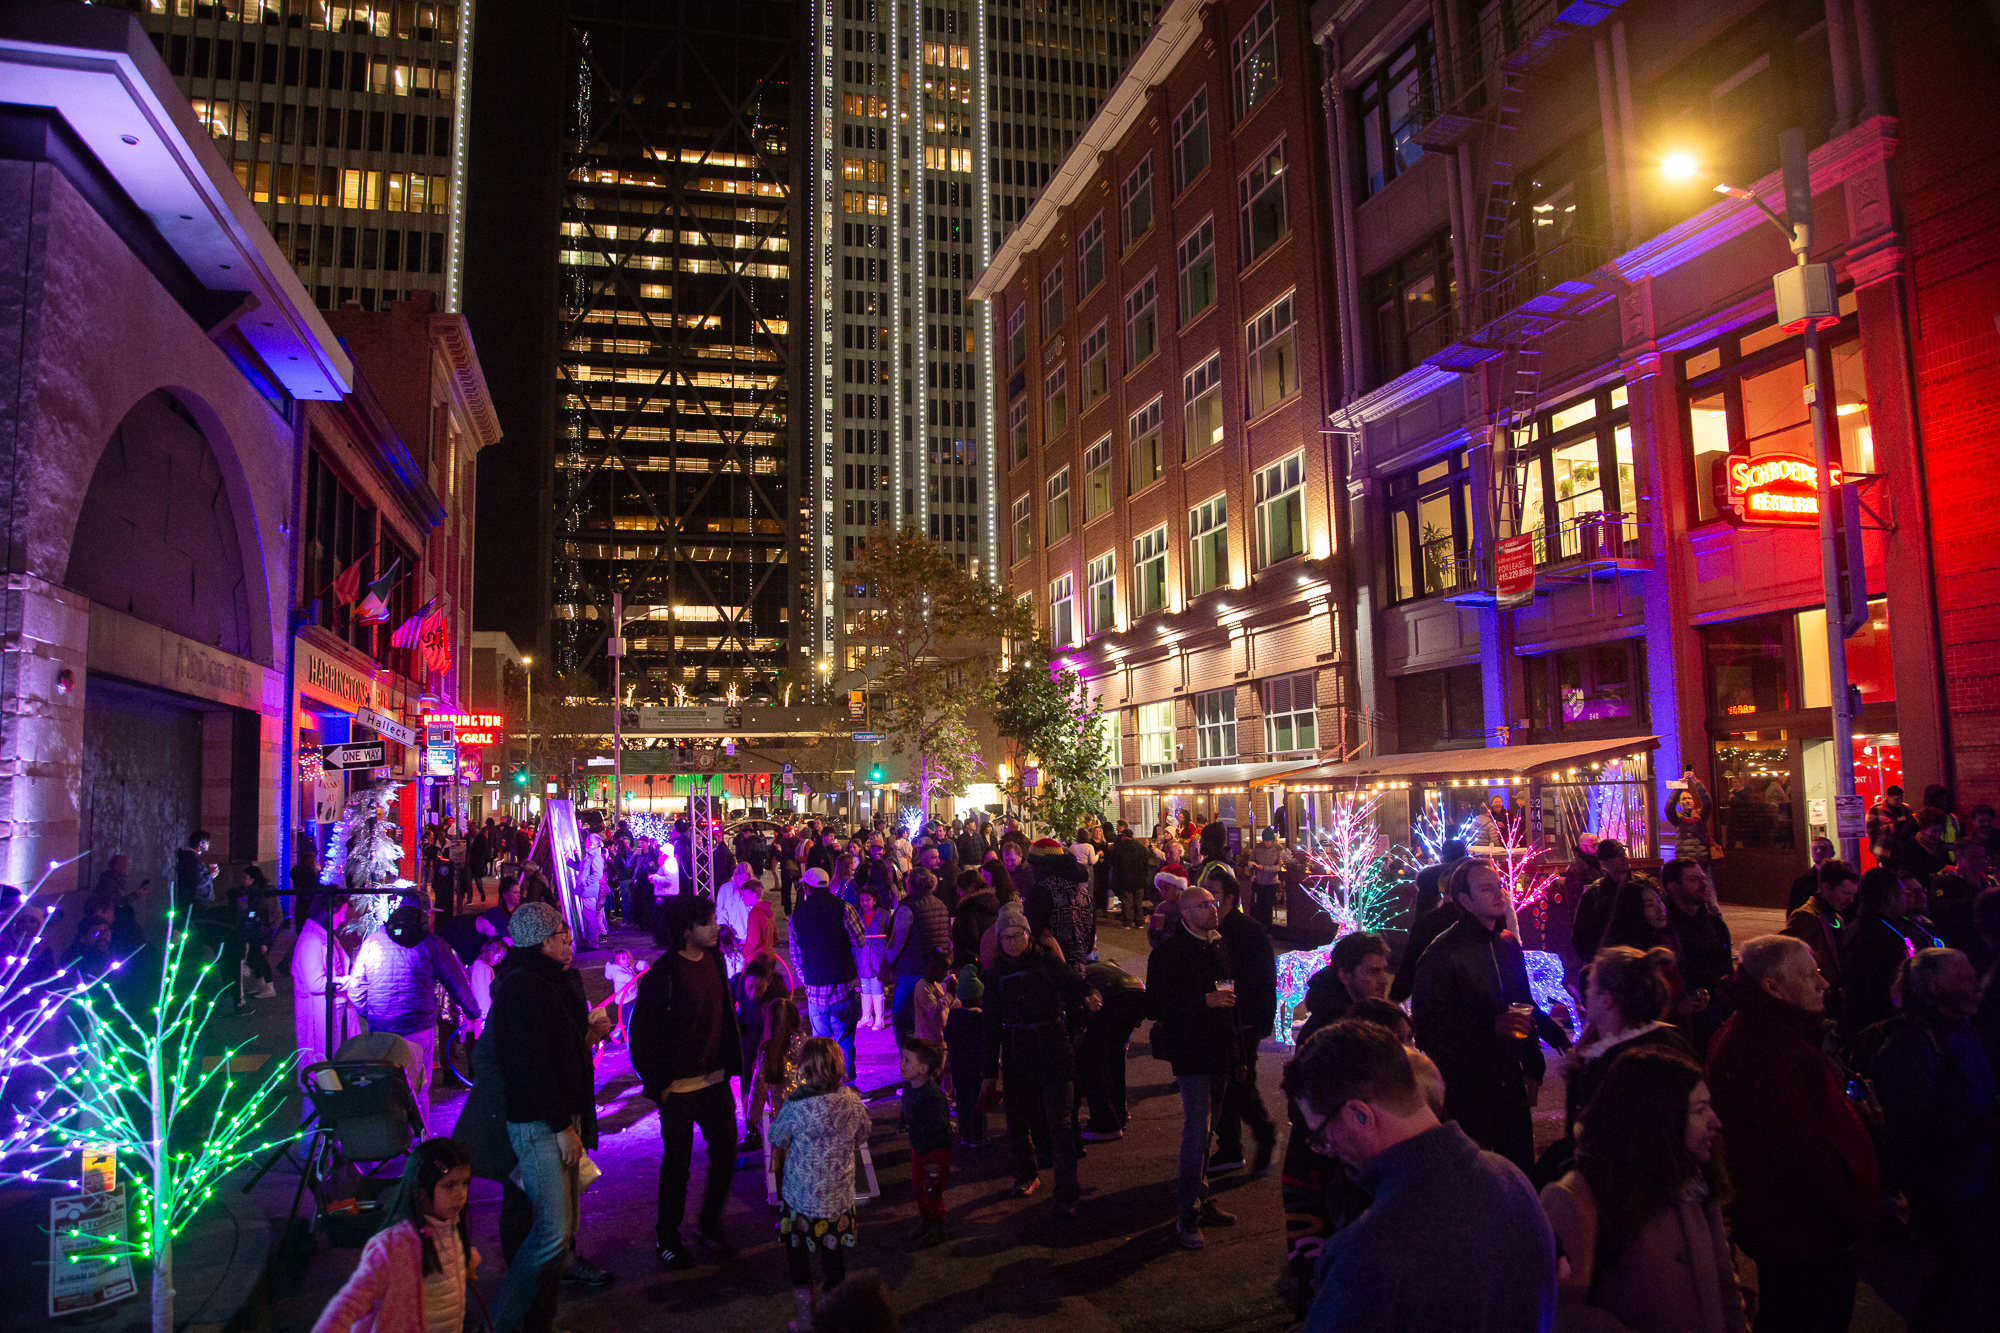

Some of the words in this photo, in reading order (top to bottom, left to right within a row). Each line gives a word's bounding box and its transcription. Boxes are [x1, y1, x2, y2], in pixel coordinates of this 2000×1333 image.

[1751, 493, 1820, 513] RESTAURA
[1498, 564, 1510, 573] FOR
[1510, 560, 1526, 570] LEASE
[367, 714, 407, 739] Halleck
[342, 751, 361, 762] ONE
[363, 748, 380, 760] WAY
[491, 764, 501, 778] P
[784, 763, 792, 773] P
[81, 1212, 123, 1229] STOPPING
